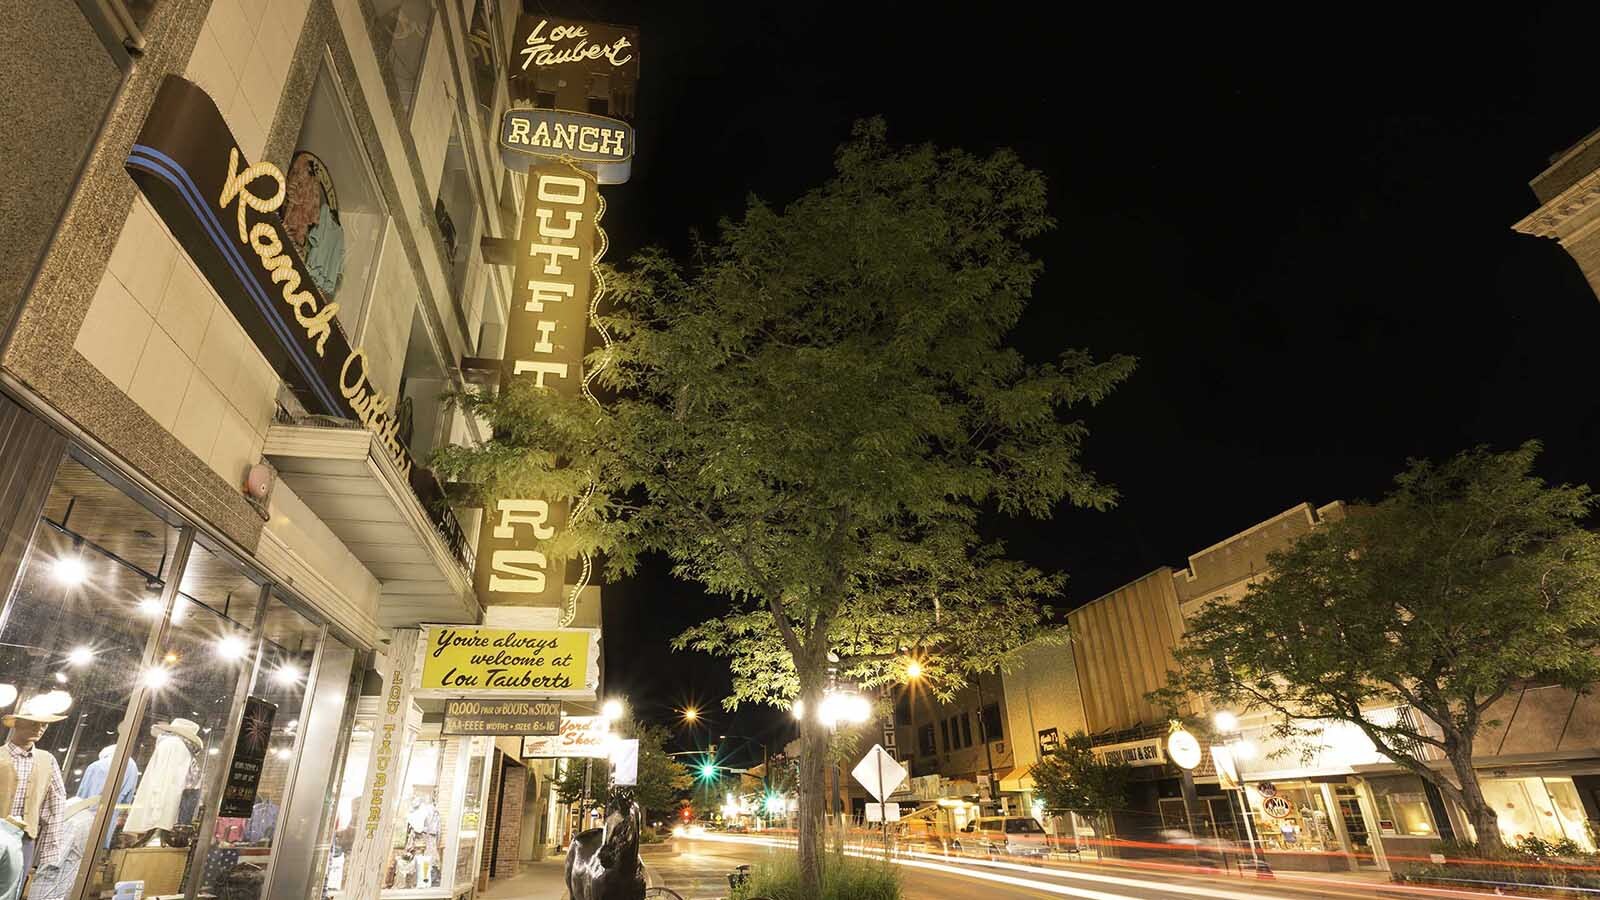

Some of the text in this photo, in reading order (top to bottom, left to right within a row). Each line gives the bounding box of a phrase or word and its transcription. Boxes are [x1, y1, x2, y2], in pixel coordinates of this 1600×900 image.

[526, 19, 589, 45] Lou
[520, 36, 632, 71] Taubert
[508, 117, 625, 156] RANCH
[219, 146, 341, 357] Ranch
[488, 175, 586, 593] OUTFITRS
[433, 629, 558, 657] You're always
[470, 650, 572, 666] welcome at
[386, 670, 404, 715] LOU
[441, 667, 572, 689] Lou Tauberts
[534, 703, 559, 716] STOCK
